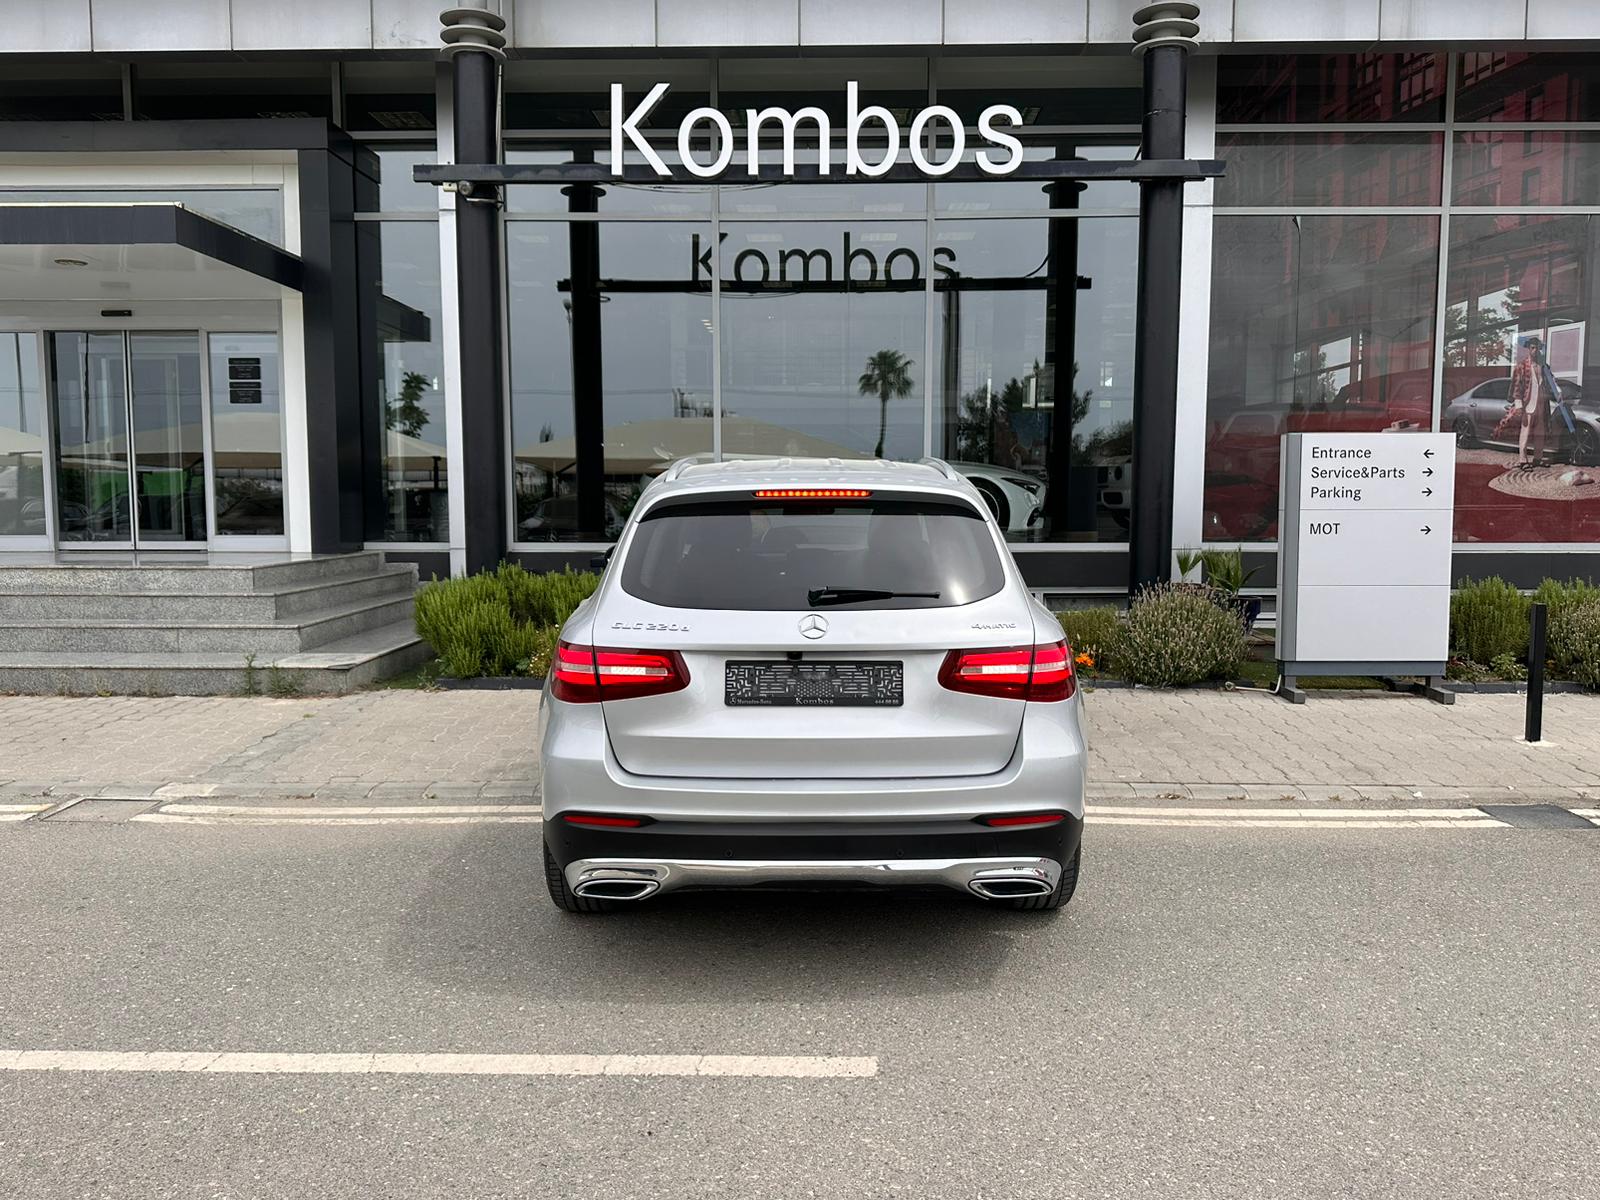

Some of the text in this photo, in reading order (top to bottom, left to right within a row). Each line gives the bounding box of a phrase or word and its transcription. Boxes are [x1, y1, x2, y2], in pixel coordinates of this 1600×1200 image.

[610, 80, 1024, 177] Kombos
[691, 231, 960, 288] Kombos
[1312, 446, 1372, 459] Entrance
[1310, 466, 1406, 479] Service&Parts
[1310, 486, 1362, 501] Parking
[1309, 522, 1341, 535] MOT
[795, 697, 835, 706] Kombos
